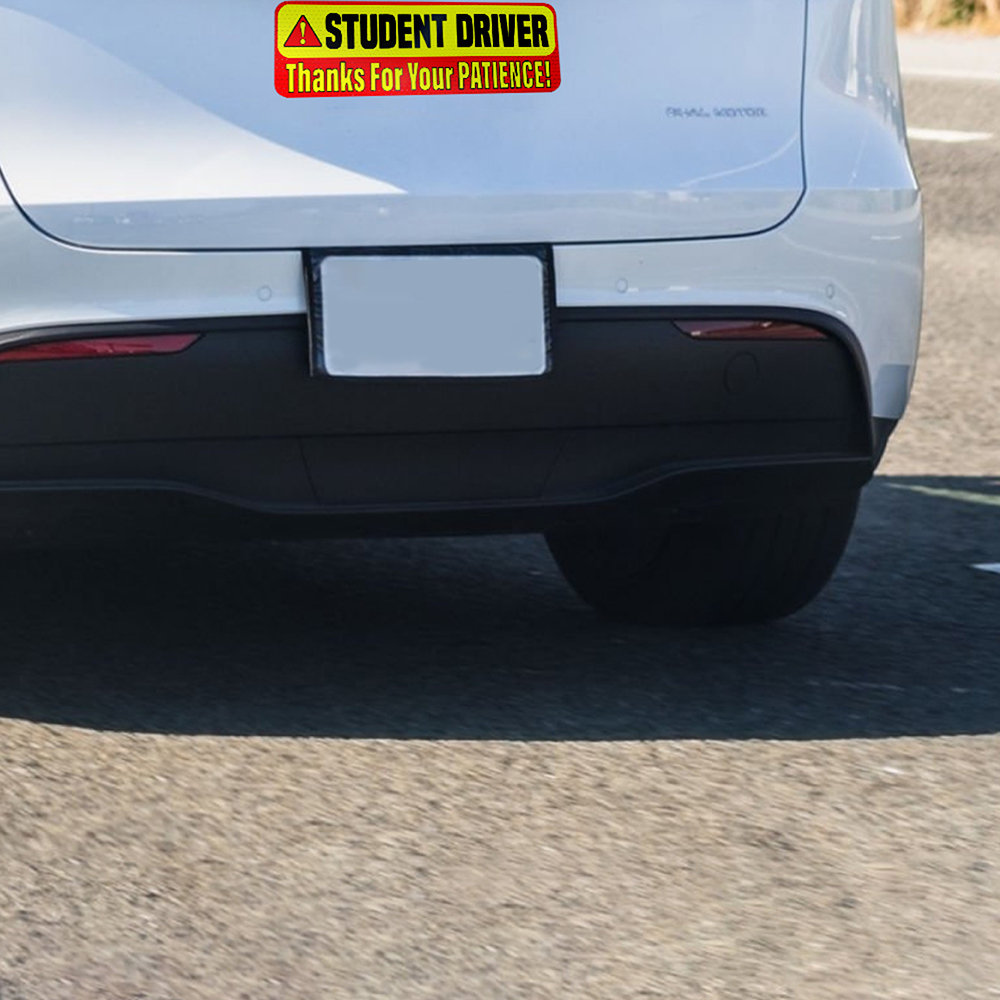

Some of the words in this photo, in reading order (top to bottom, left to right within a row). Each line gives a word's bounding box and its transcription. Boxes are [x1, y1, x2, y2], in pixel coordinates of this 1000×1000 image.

[325, 12, 447, 50] STUDENT
[456, 13, 549, 48] DRIVER
[286, 61, 365, 93] Thanks
[370, 62, 403, 92] For
[408, 62, 455, 91] Your
[458, 60, 551, 90] PATIENCE!
